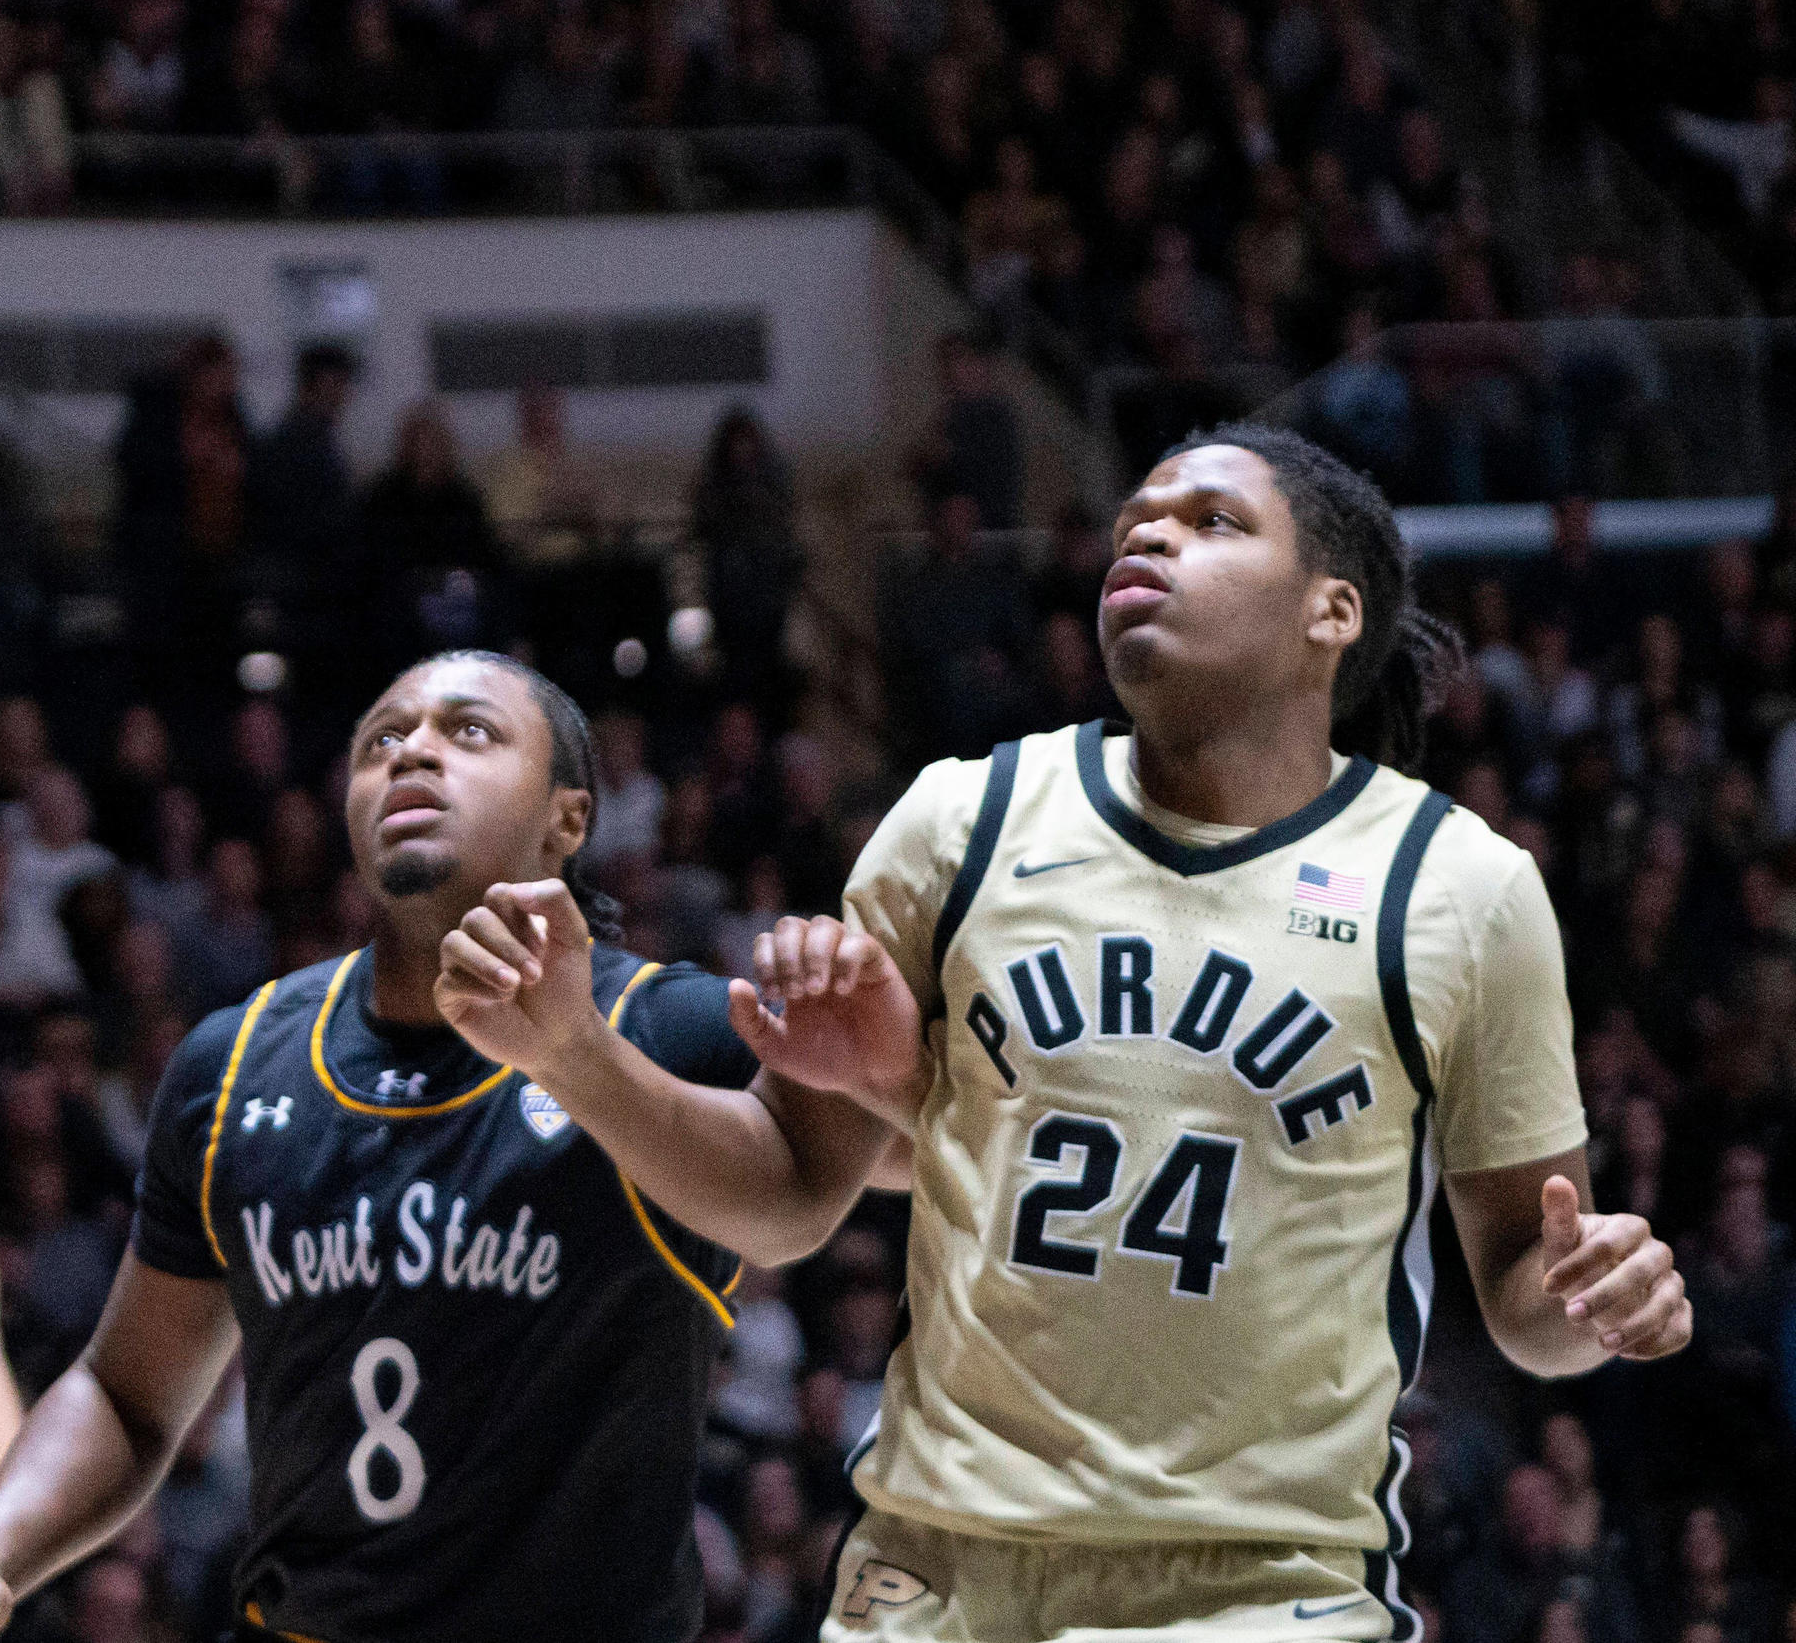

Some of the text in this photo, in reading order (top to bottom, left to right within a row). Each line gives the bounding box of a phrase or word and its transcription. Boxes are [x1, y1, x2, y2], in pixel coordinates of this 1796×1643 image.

[965, 932, 1375, 1147] PURDUE
[241, 1181, 561, 1305] Kent State
[1006, 1109, 1243, 1301] 24
[347, 1336, 426, 1524] 8
